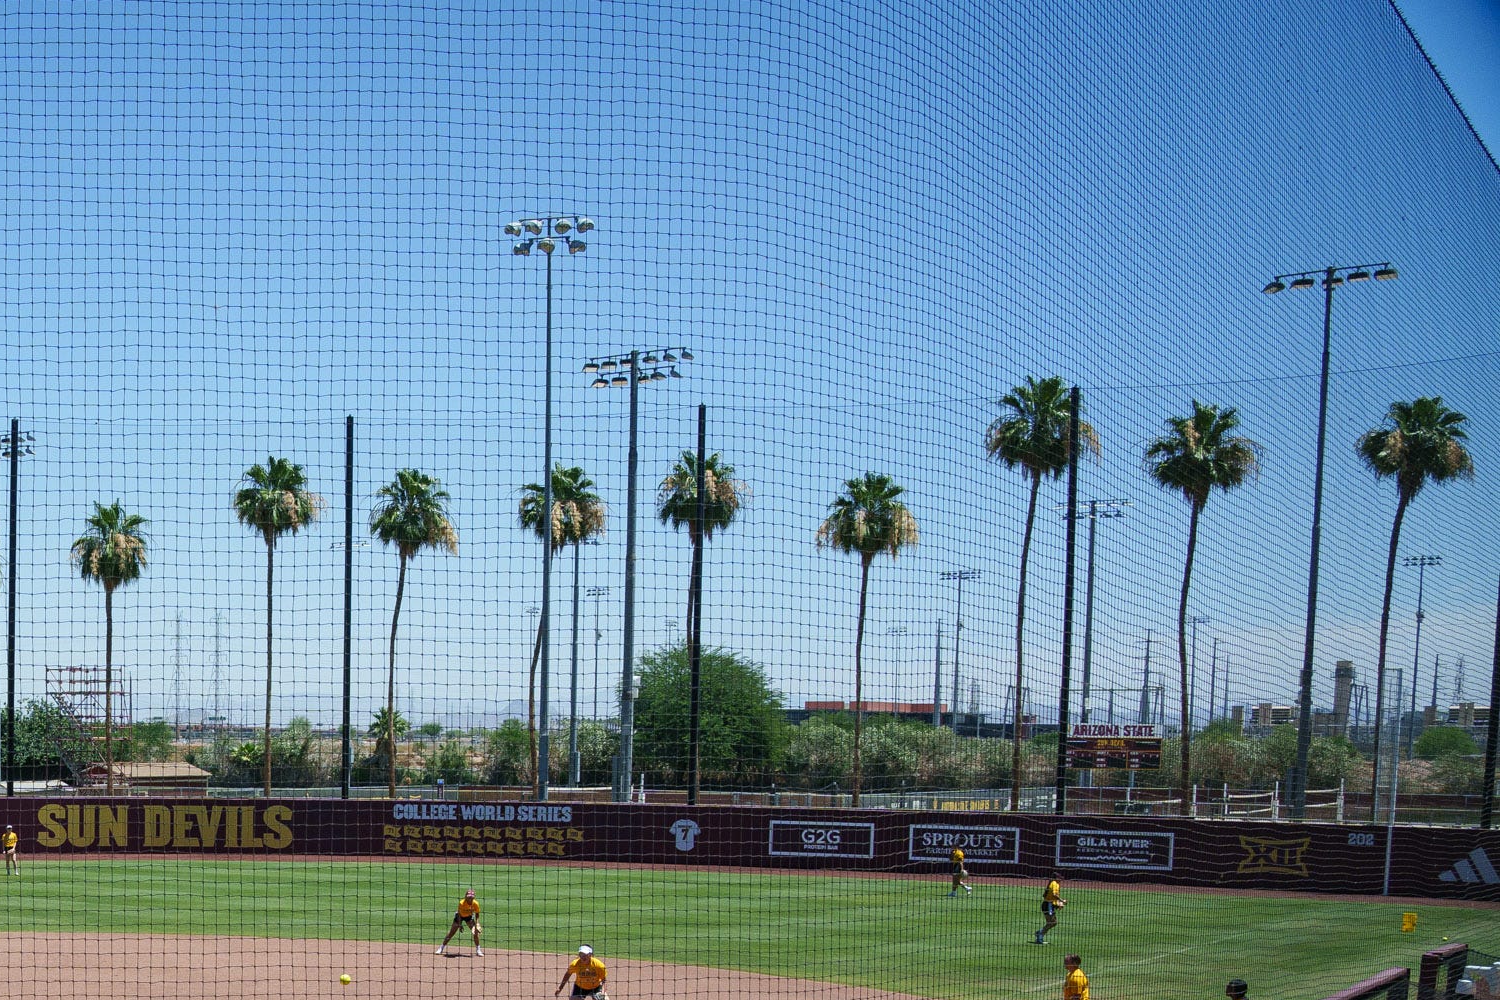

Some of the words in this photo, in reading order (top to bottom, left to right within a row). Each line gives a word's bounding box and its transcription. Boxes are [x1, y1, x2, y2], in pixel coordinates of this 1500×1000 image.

[1073, 724, 1120, 737] ARIZONA
[1123, 725, 1155, 737] STATE
[393, 804, 458, 820] COLLEGE
[460, 804, 515, 821] WORLD
[517, 806, 572, 823] SERIES
[37, 803, 130, 848] SUN
[143, 804, 293, 849] DEVILS
[681, 828, 689, 840] 7
[801, 829, 840, 844] G2G
[922, 832, 1004, 848] SPROUTS
[1348, 833, 1374, 845] 202
[1077, 837, 1107, 847] GILA
[1110, 838, 1149, 848] RIVER
